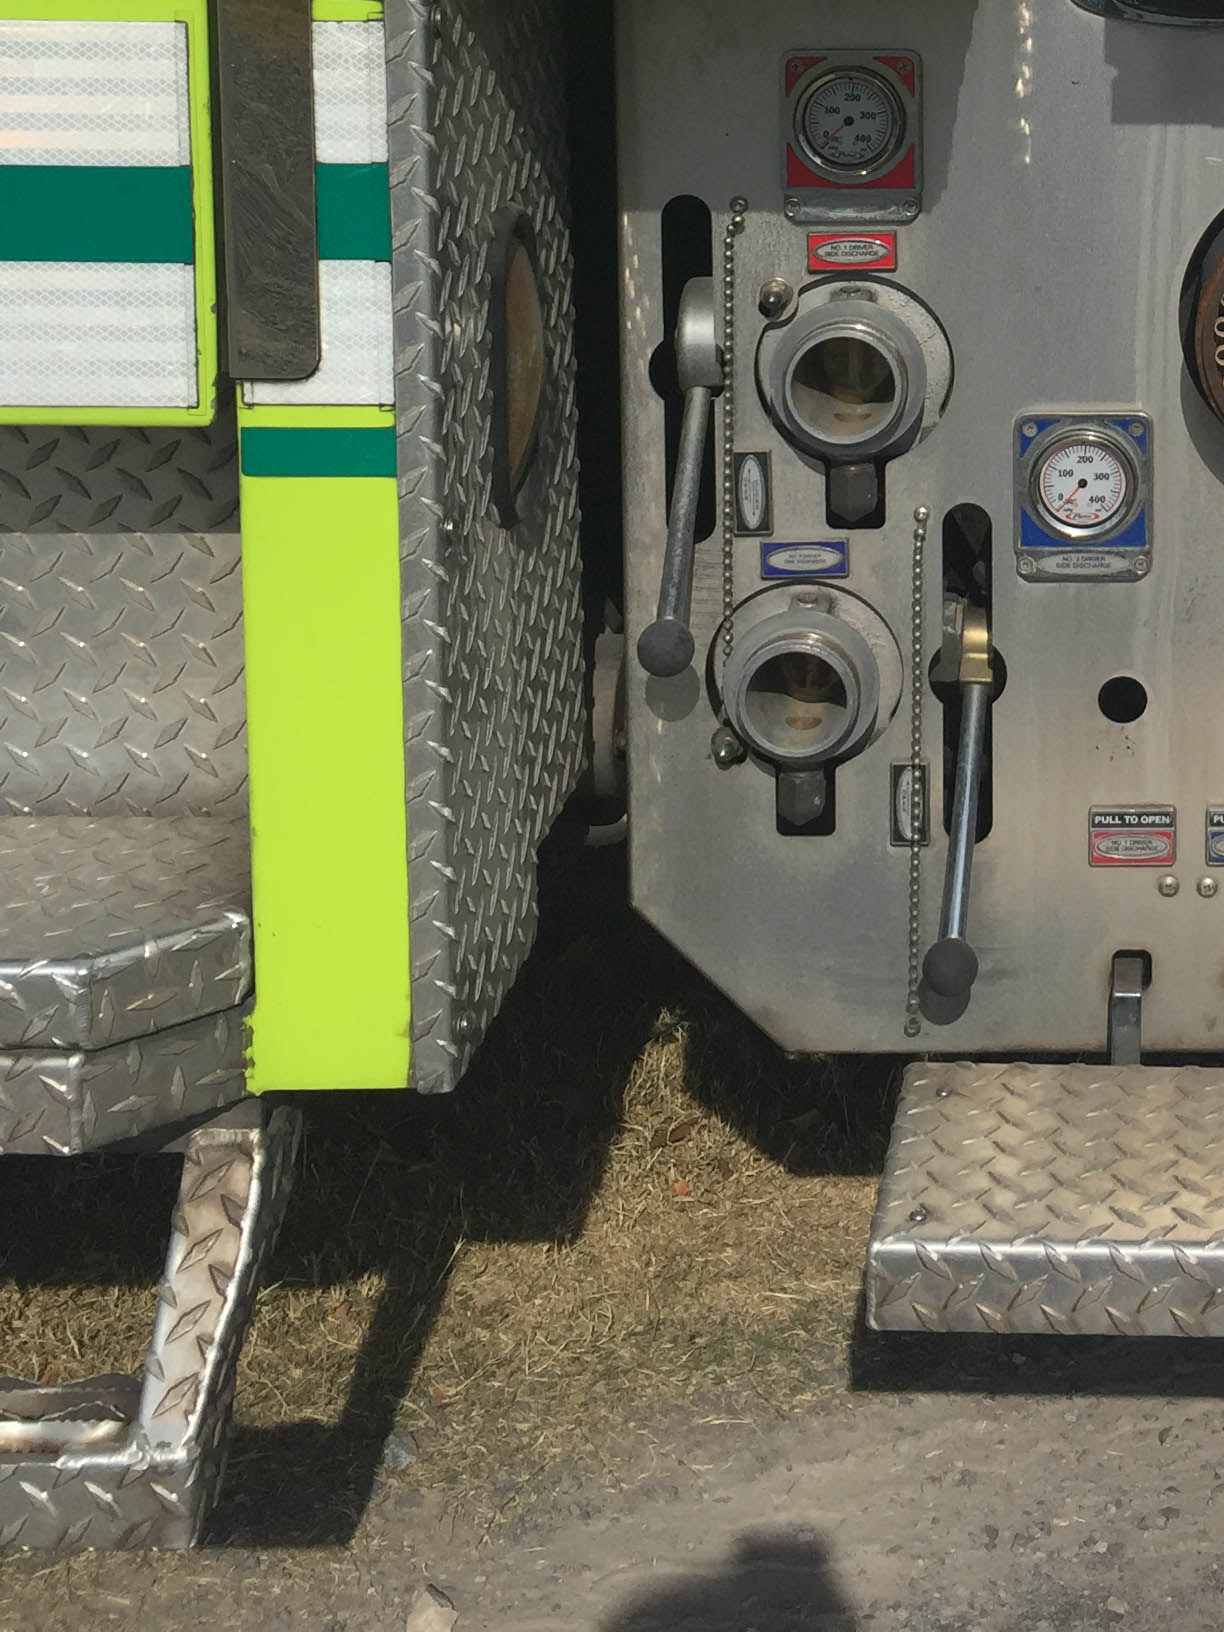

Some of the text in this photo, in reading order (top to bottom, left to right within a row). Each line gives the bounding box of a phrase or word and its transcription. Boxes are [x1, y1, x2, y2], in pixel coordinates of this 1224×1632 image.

[844, 93, 861, 102] 200
[824, 106, 841, 114] 100
[860, 111, 877, 120] 300
[823, 130, 830, 138] 0
[854, 134, 872, 143] 400
[1077, 455, 1094, 464] 200
[1058, 469, 1074, 478] 100
[1093, 472, 1110, 481] 300
[1057, 493, 1064, 501] 0
[1088, 495, 1106, 504] 400
[1094, 815, 1171, 825] PULL TO OPEN
